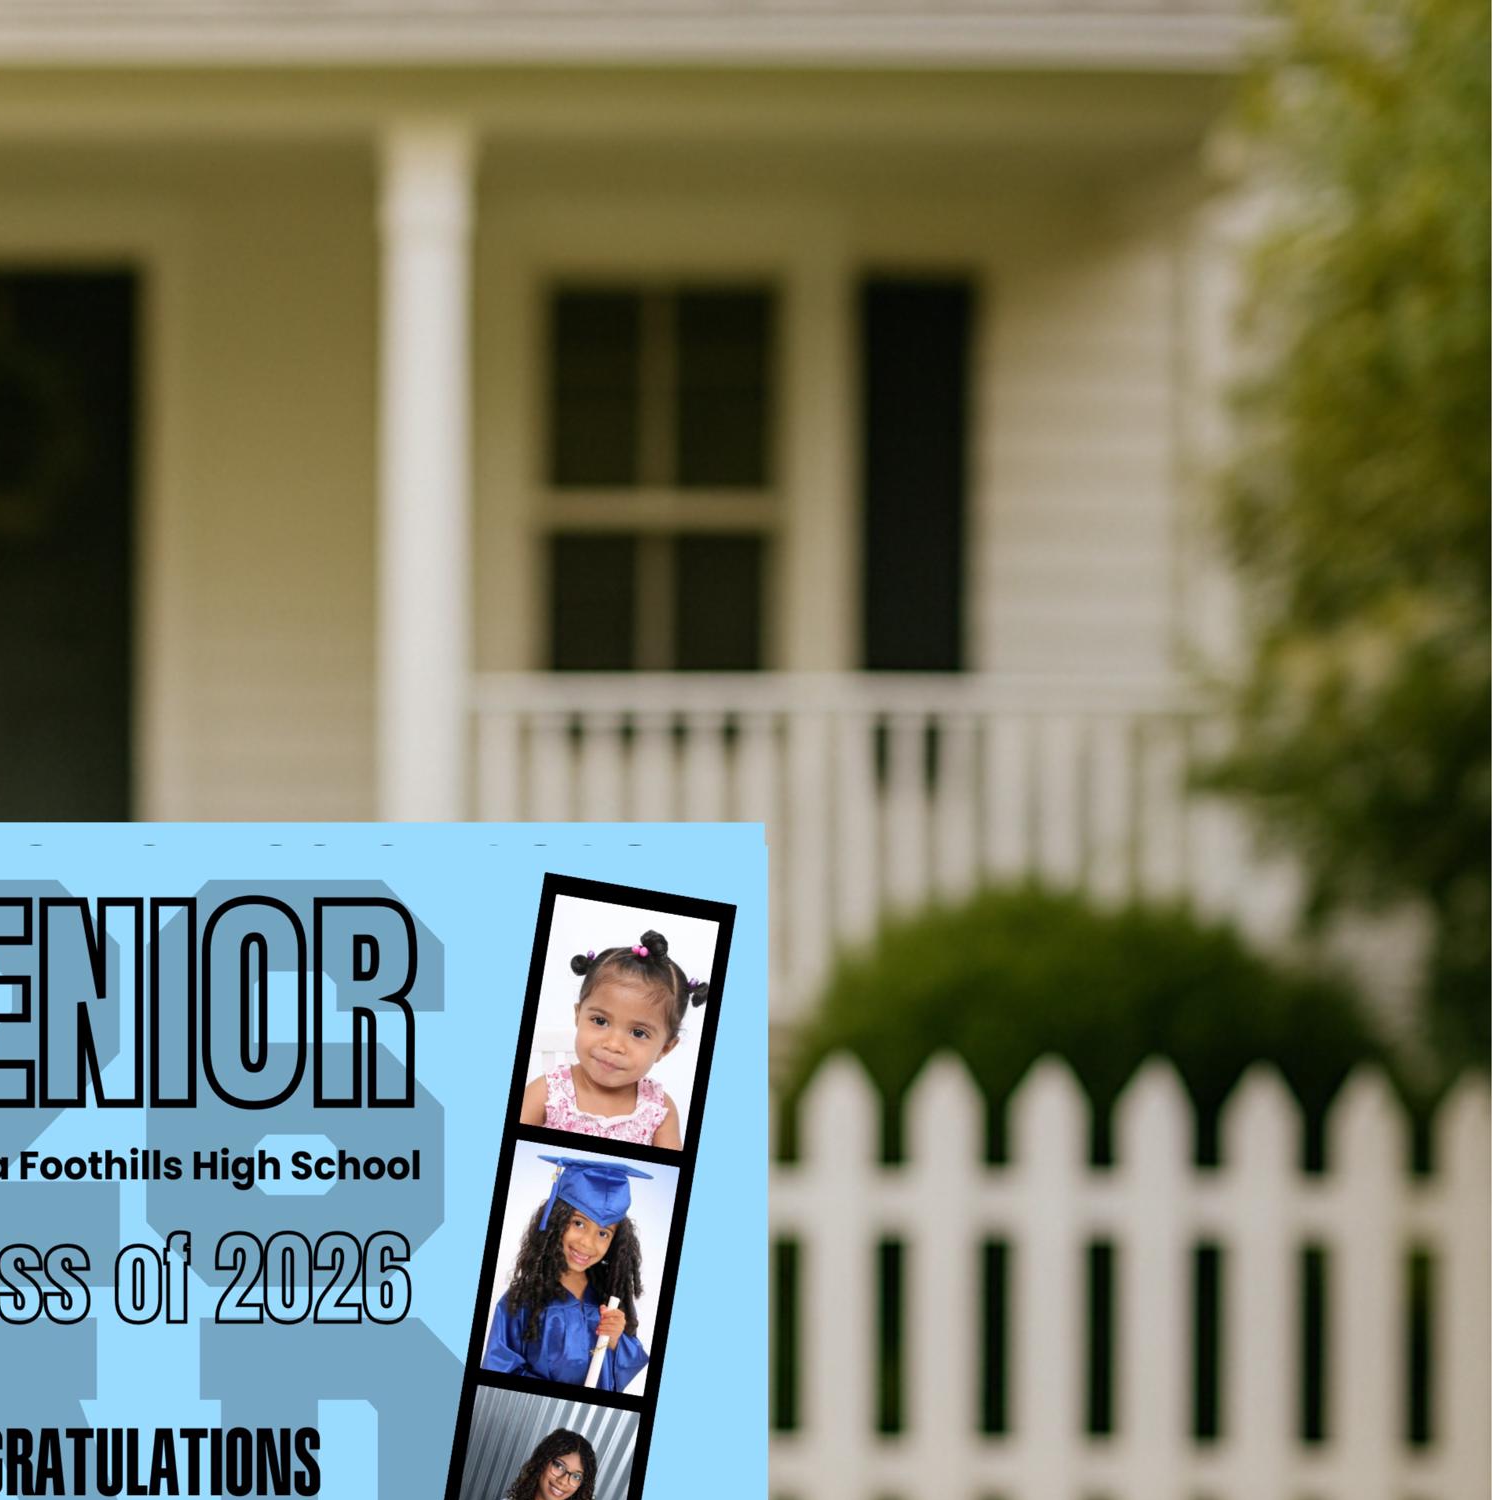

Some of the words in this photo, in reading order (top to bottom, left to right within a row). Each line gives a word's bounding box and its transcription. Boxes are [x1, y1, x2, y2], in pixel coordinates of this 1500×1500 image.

[20, 1147, 183, 1181] Foothills
[193, 1147, 281, 1191] High
[291, 1149, 420, 1181] School
[114, 1230, 192, 1325] of
[214, 1230, 412, 1326] 2026
